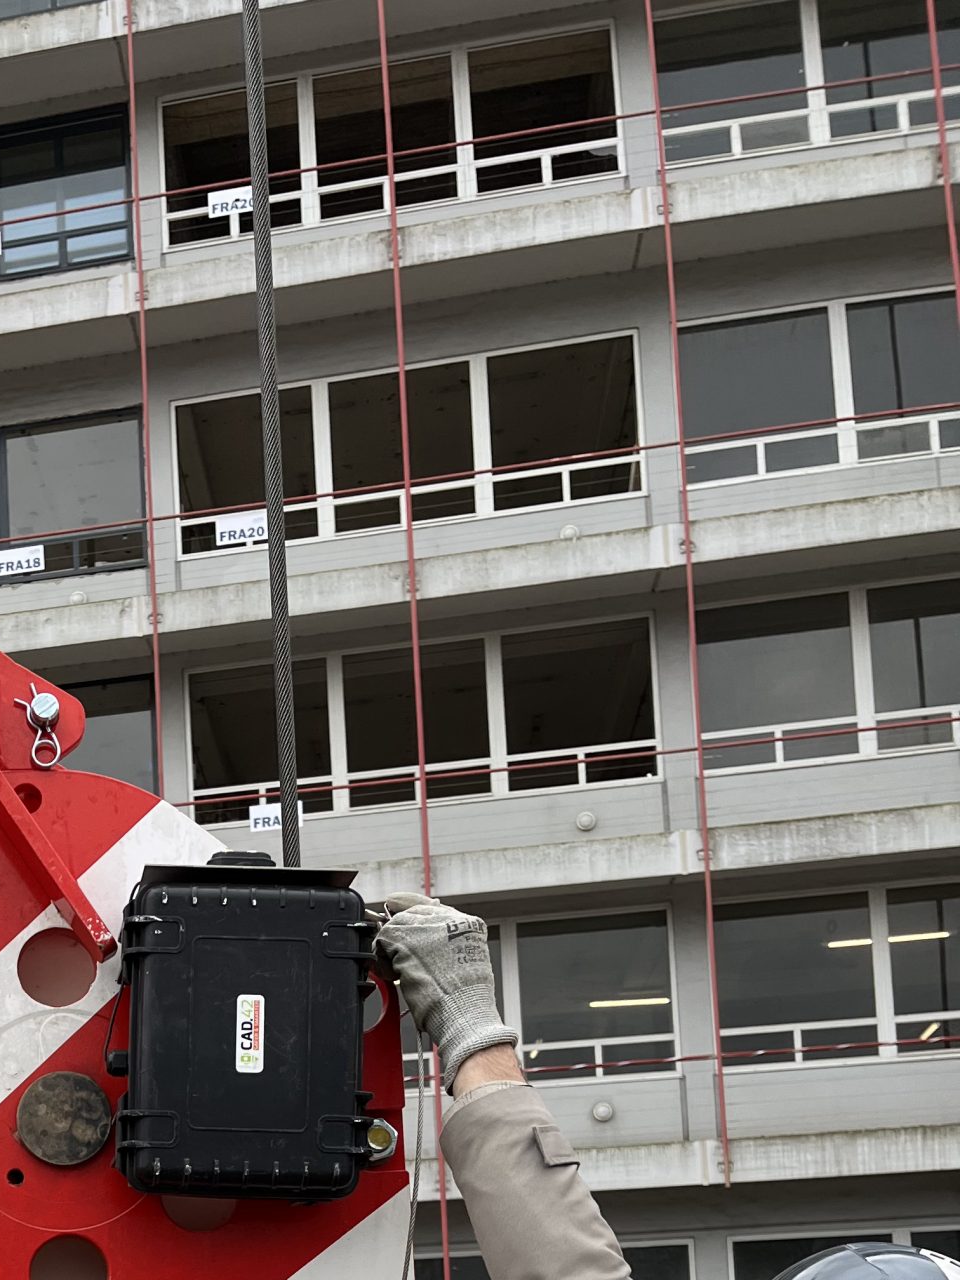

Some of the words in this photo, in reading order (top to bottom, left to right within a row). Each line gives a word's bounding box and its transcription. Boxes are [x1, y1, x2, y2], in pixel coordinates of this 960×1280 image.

[220, 526, 265, 542] FRA20
[253, 816, 281, 829] FRA
[241, 1000, 253, 1050] CAD.42
